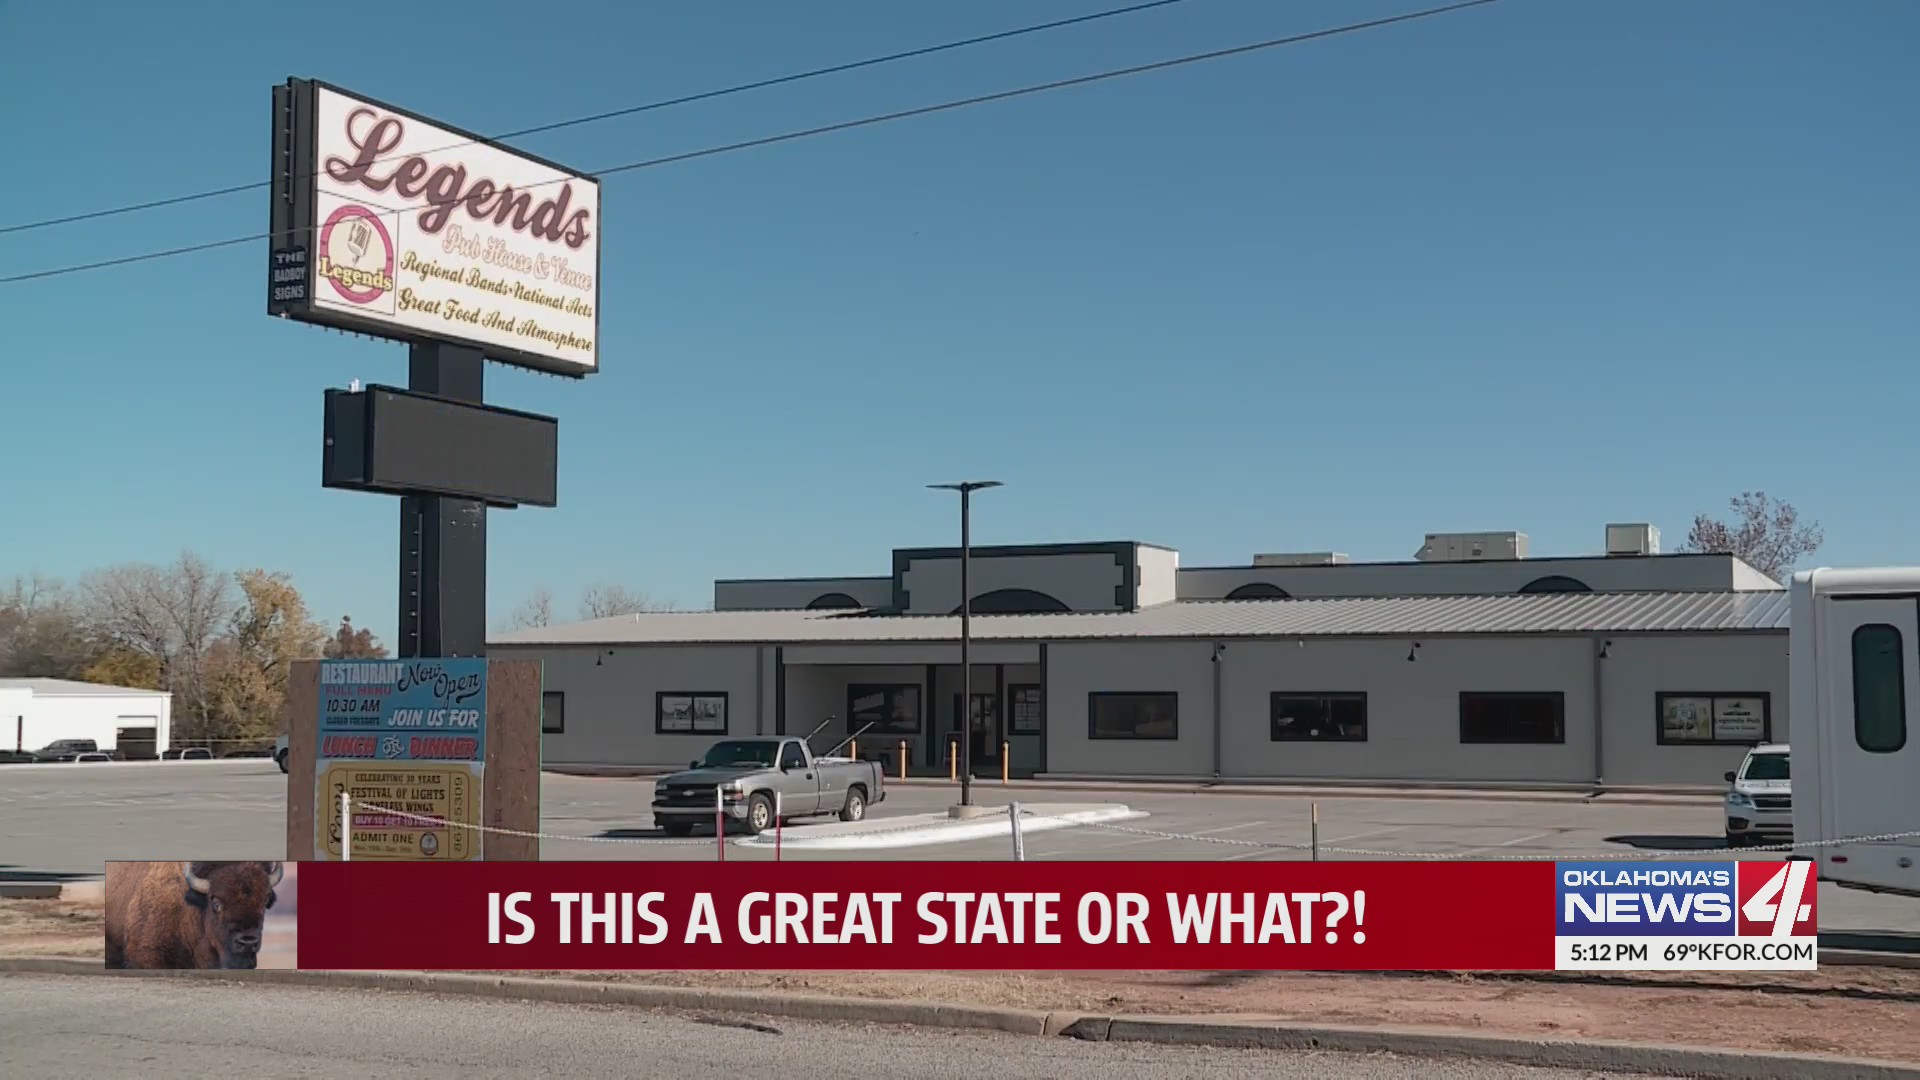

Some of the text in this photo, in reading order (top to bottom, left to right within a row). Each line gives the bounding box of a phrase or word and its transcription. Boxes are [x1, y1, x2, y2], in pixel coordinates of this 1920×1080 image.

[325, 107, 592, 250] Legends
[275, 252, 305, 264] THE
[442, 223, 593, 292] Pub House & Venue
[273, 267, 305, 283] BADBOY
[319, 255, 394, 292] Legends
[273, 284, 304, 301] SIGNS
[400, 251, 464, 281] Regional
[566, 298, 593, 318] Acts
[399, 288, 593, 352] Great Food And Atmosphere
[321, 663, 442, 692] RESTAURANT Now
[325, 686, 392, 696] FULL MENU
[434, 672, 482, 711] Open
[361, 700, 380, 712] AM
[388, 709, 479, 728] JOIN US FOR
[322, 735, 378, 758] LUNCH
[409, 737, 478, 760] DINNER
[418, 775, 441, 785] YEARS
[351, 787, 445, 801] FESTIVAL OF LIGHTS
[406, 802, 434, 813] WINGS
[355, 815, 372, 825] BUY
[352, 833, 414, 845] ADMIT ONE
